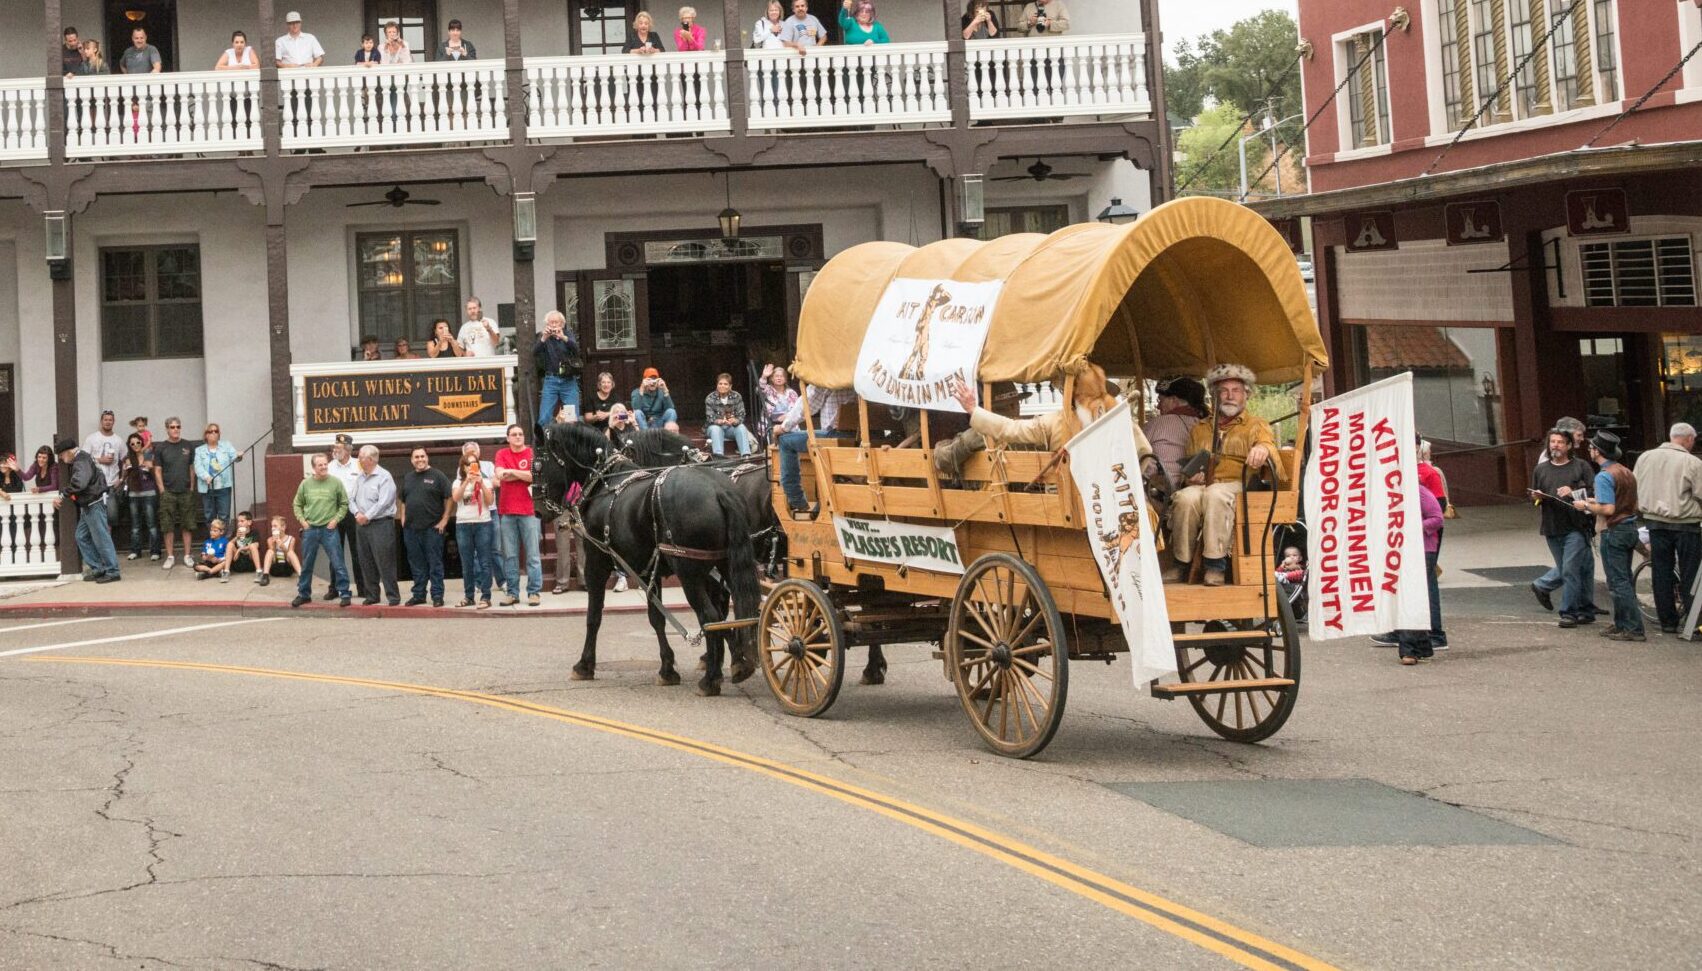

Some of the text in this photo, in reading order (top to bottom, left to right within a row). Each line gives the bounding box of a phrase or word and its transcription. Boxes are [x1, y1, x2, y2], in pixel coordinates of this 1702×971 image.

[312, 374, 498, 398] LOCAL WINES FULL BAR
[868, 359, 966, 405] MOUNTAIN MEN
[313, 404, 411, 424] RESTAURANT
[443, 400, 479, 409] DOWNSTAIRS
[1112, 463, 1138, 510] KIT
[1371, 417, 1405, 595] KIT CARSON
[1319, 407, 1344, 632] AMADOR COUNTY
[840, 527, 898, 558] PLASSE'S
[900, 535, 959, 565] RESORT
